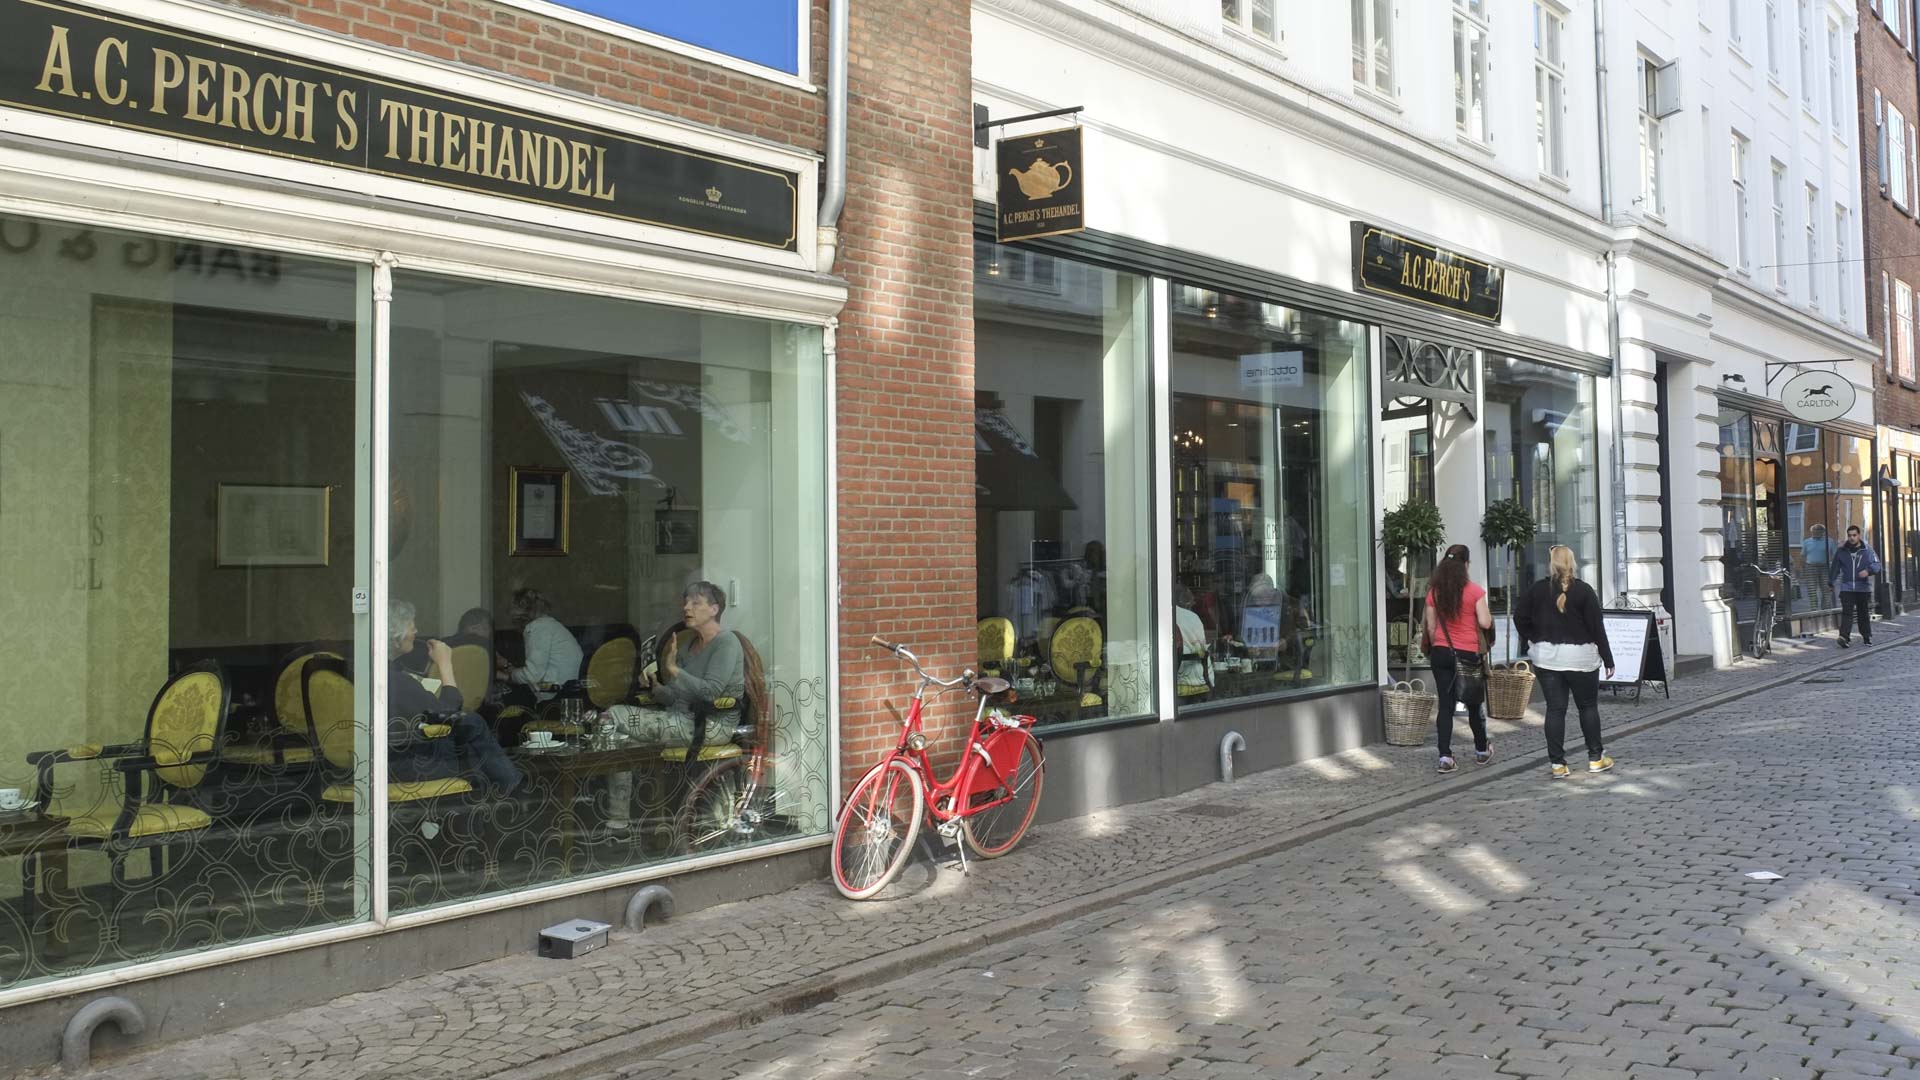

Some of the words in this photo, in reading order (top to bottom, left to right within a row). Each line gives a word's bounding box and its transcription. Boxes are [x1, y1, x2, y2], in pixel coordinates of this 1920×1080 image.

[35, 25, 138, 109] A.C.
[380, 98, 615, 201] THEHANDEL
[1042, 203, 1080, 219] THEHANDEL
[1401, 252, 1422, 289] A.C.
[1797, 399, 1839, 408] CARLTON
